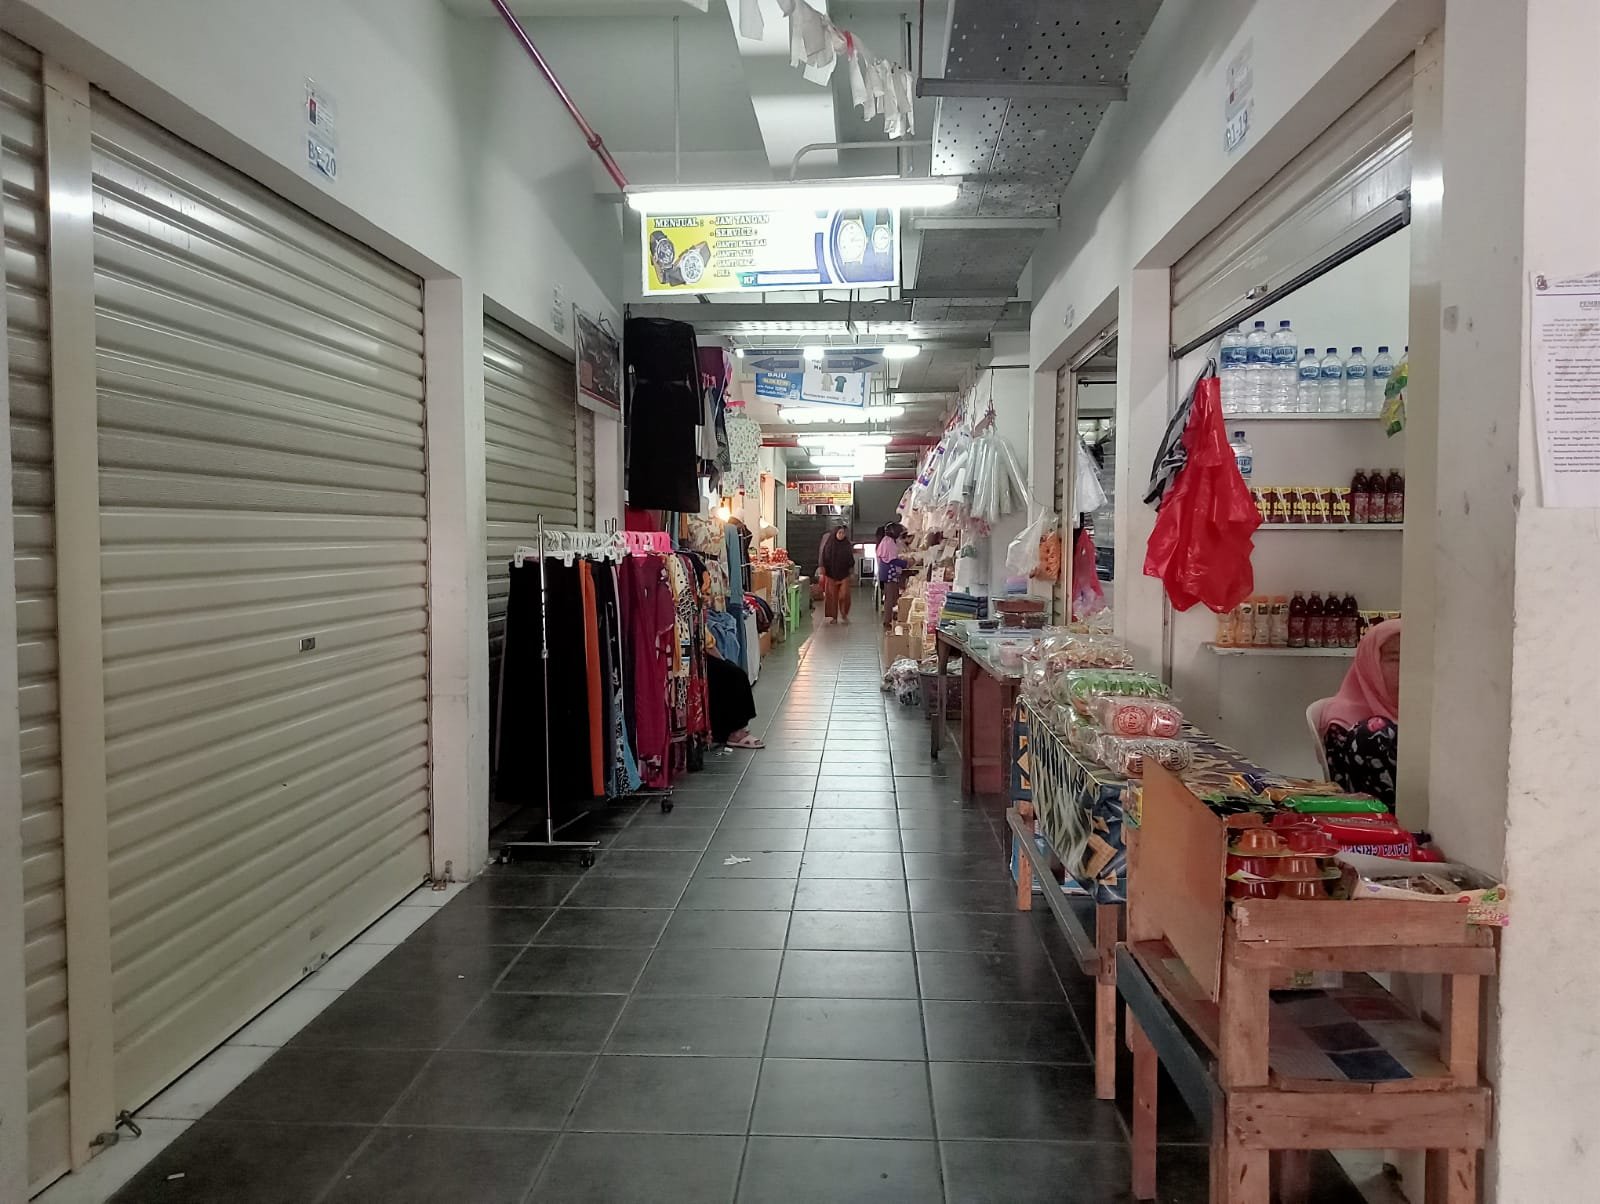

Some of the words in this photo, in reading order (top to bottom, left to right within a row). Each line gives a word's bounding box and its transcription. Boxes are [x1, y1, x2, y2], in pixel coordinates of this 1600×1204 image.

[654, 217, 699, 228] MENJUAL
[715, 216, 733, 226] JAM
[734, 215, 769, 225] TANGAN
[715, 227, 752, 237] SERVICE
